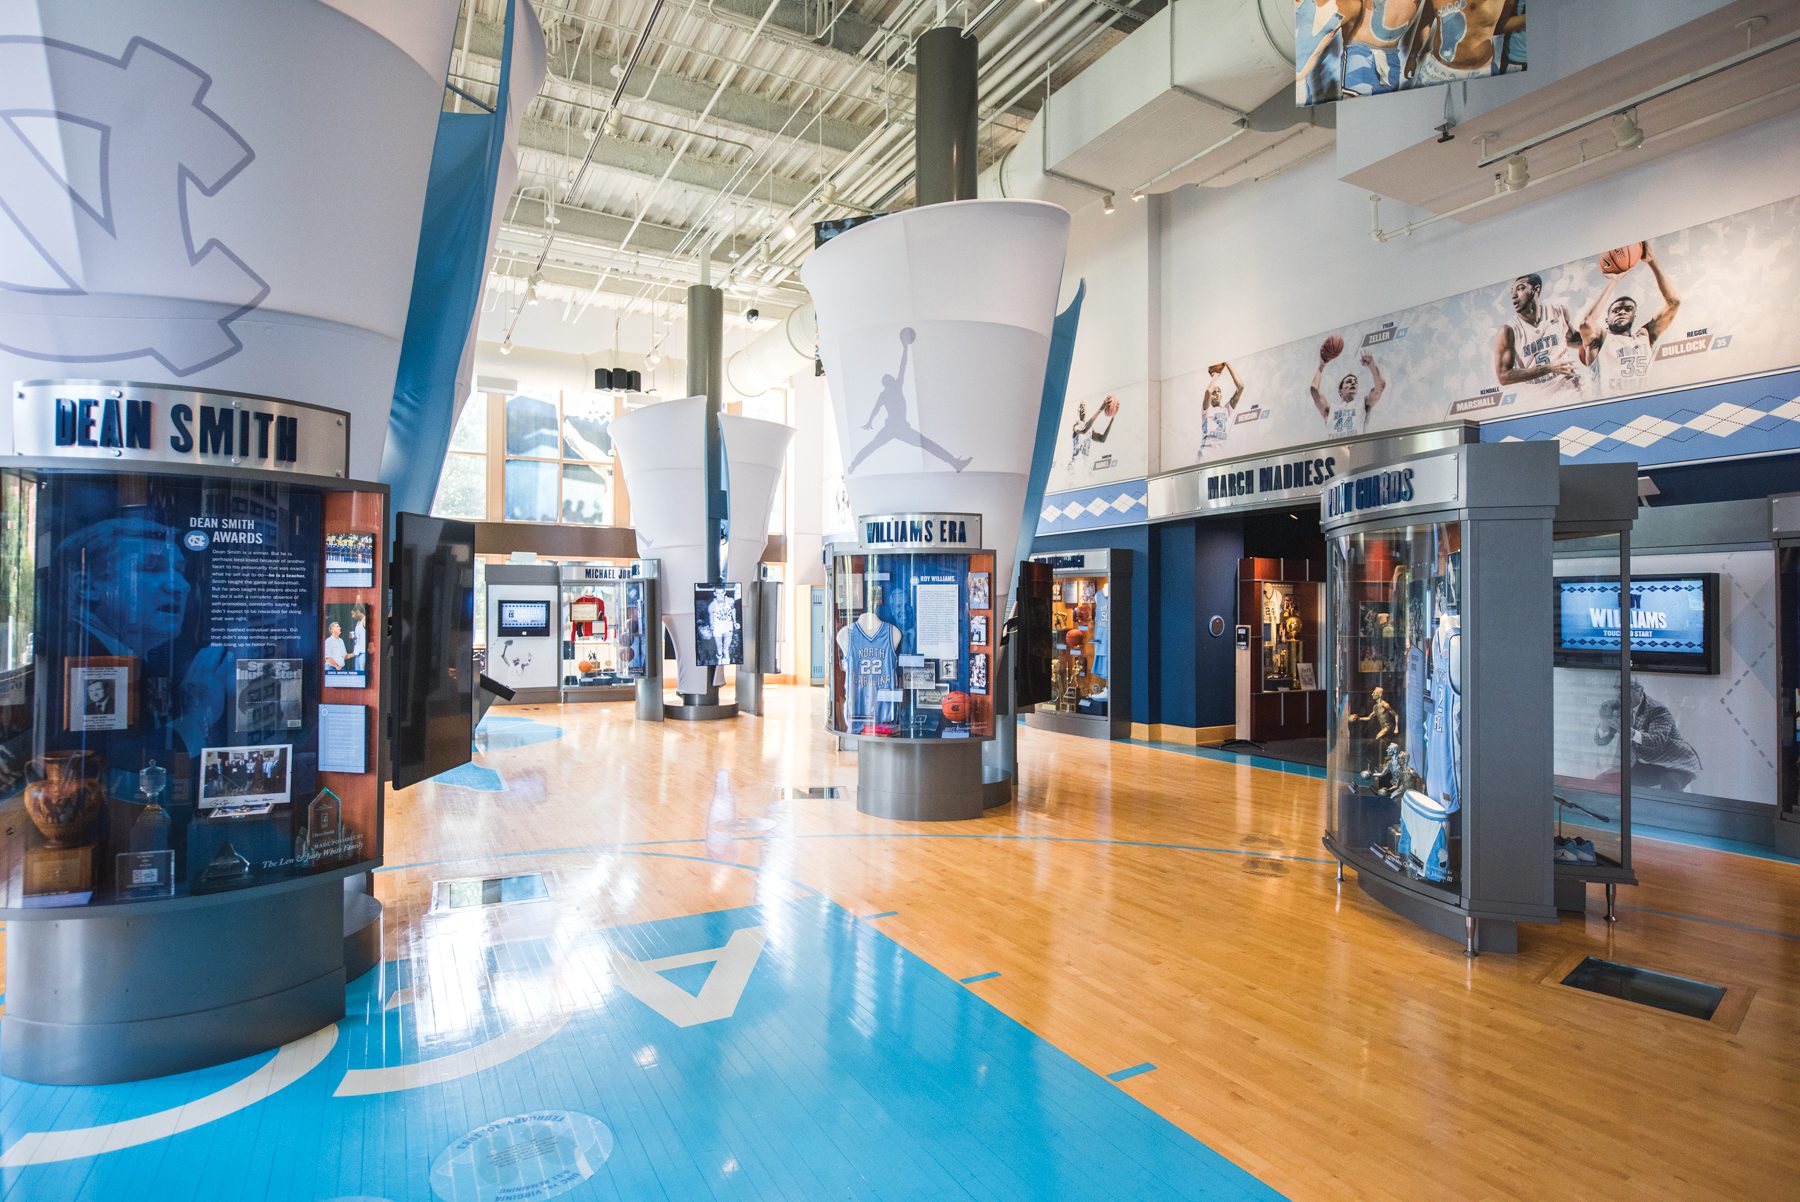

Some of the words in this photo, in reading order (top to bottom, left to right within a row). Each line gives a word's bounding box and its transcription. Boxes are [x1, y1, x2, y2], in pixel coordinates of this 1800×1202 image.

[1368, 331, 1390, 343] ZELLER
[1686, 327, 1708, 338] REGGIE
[1523, 334, 1559, 358] NORTH
[1662, 339, 1706, 357] BULLOCK
[1716, 339, 1727, 348] 35
[1620, 356, 1648, 378] 35
[1480, 386, 1500, 395] KENDALL
[1456, 396, 1496, 412] MARSHALL
[55, 398, 152, 450] DEAN
[170, 403, 297, 462] SMITH
[1334, 416, 1353, 433] 44
[1207, 469, 1254, 500] MARCH
[1259, 456, 1336, 493] MADNESS
[1355, 468, 1414, 510] GUARDS
[189, 517, 218, 529] DEAN
[222, 518, 255, 530] SMITH
[866, 520, 933, 543] WILLIAMS
[940, 520, 967, 543] ERA
[212, 531, 263, 544] AWARDS
[585, 568, 615, 579] MICHAEL
[1589, 607, 1668, 629] WILIAMS
[858, 647, 885, 659] NORTH
[861, 659, 882, 675] 22
[262, 860, 278, 869] The
[279, 856, 295, 866] Len
[323, 847, 342, 857] White
[343, 841, 364, 853] Family
[506, 1114, 566, 1126] FEBRUARY
[560, 1173, 580, 1185] UNC
[495, 1190, 543, 1202] VIRGINIA
